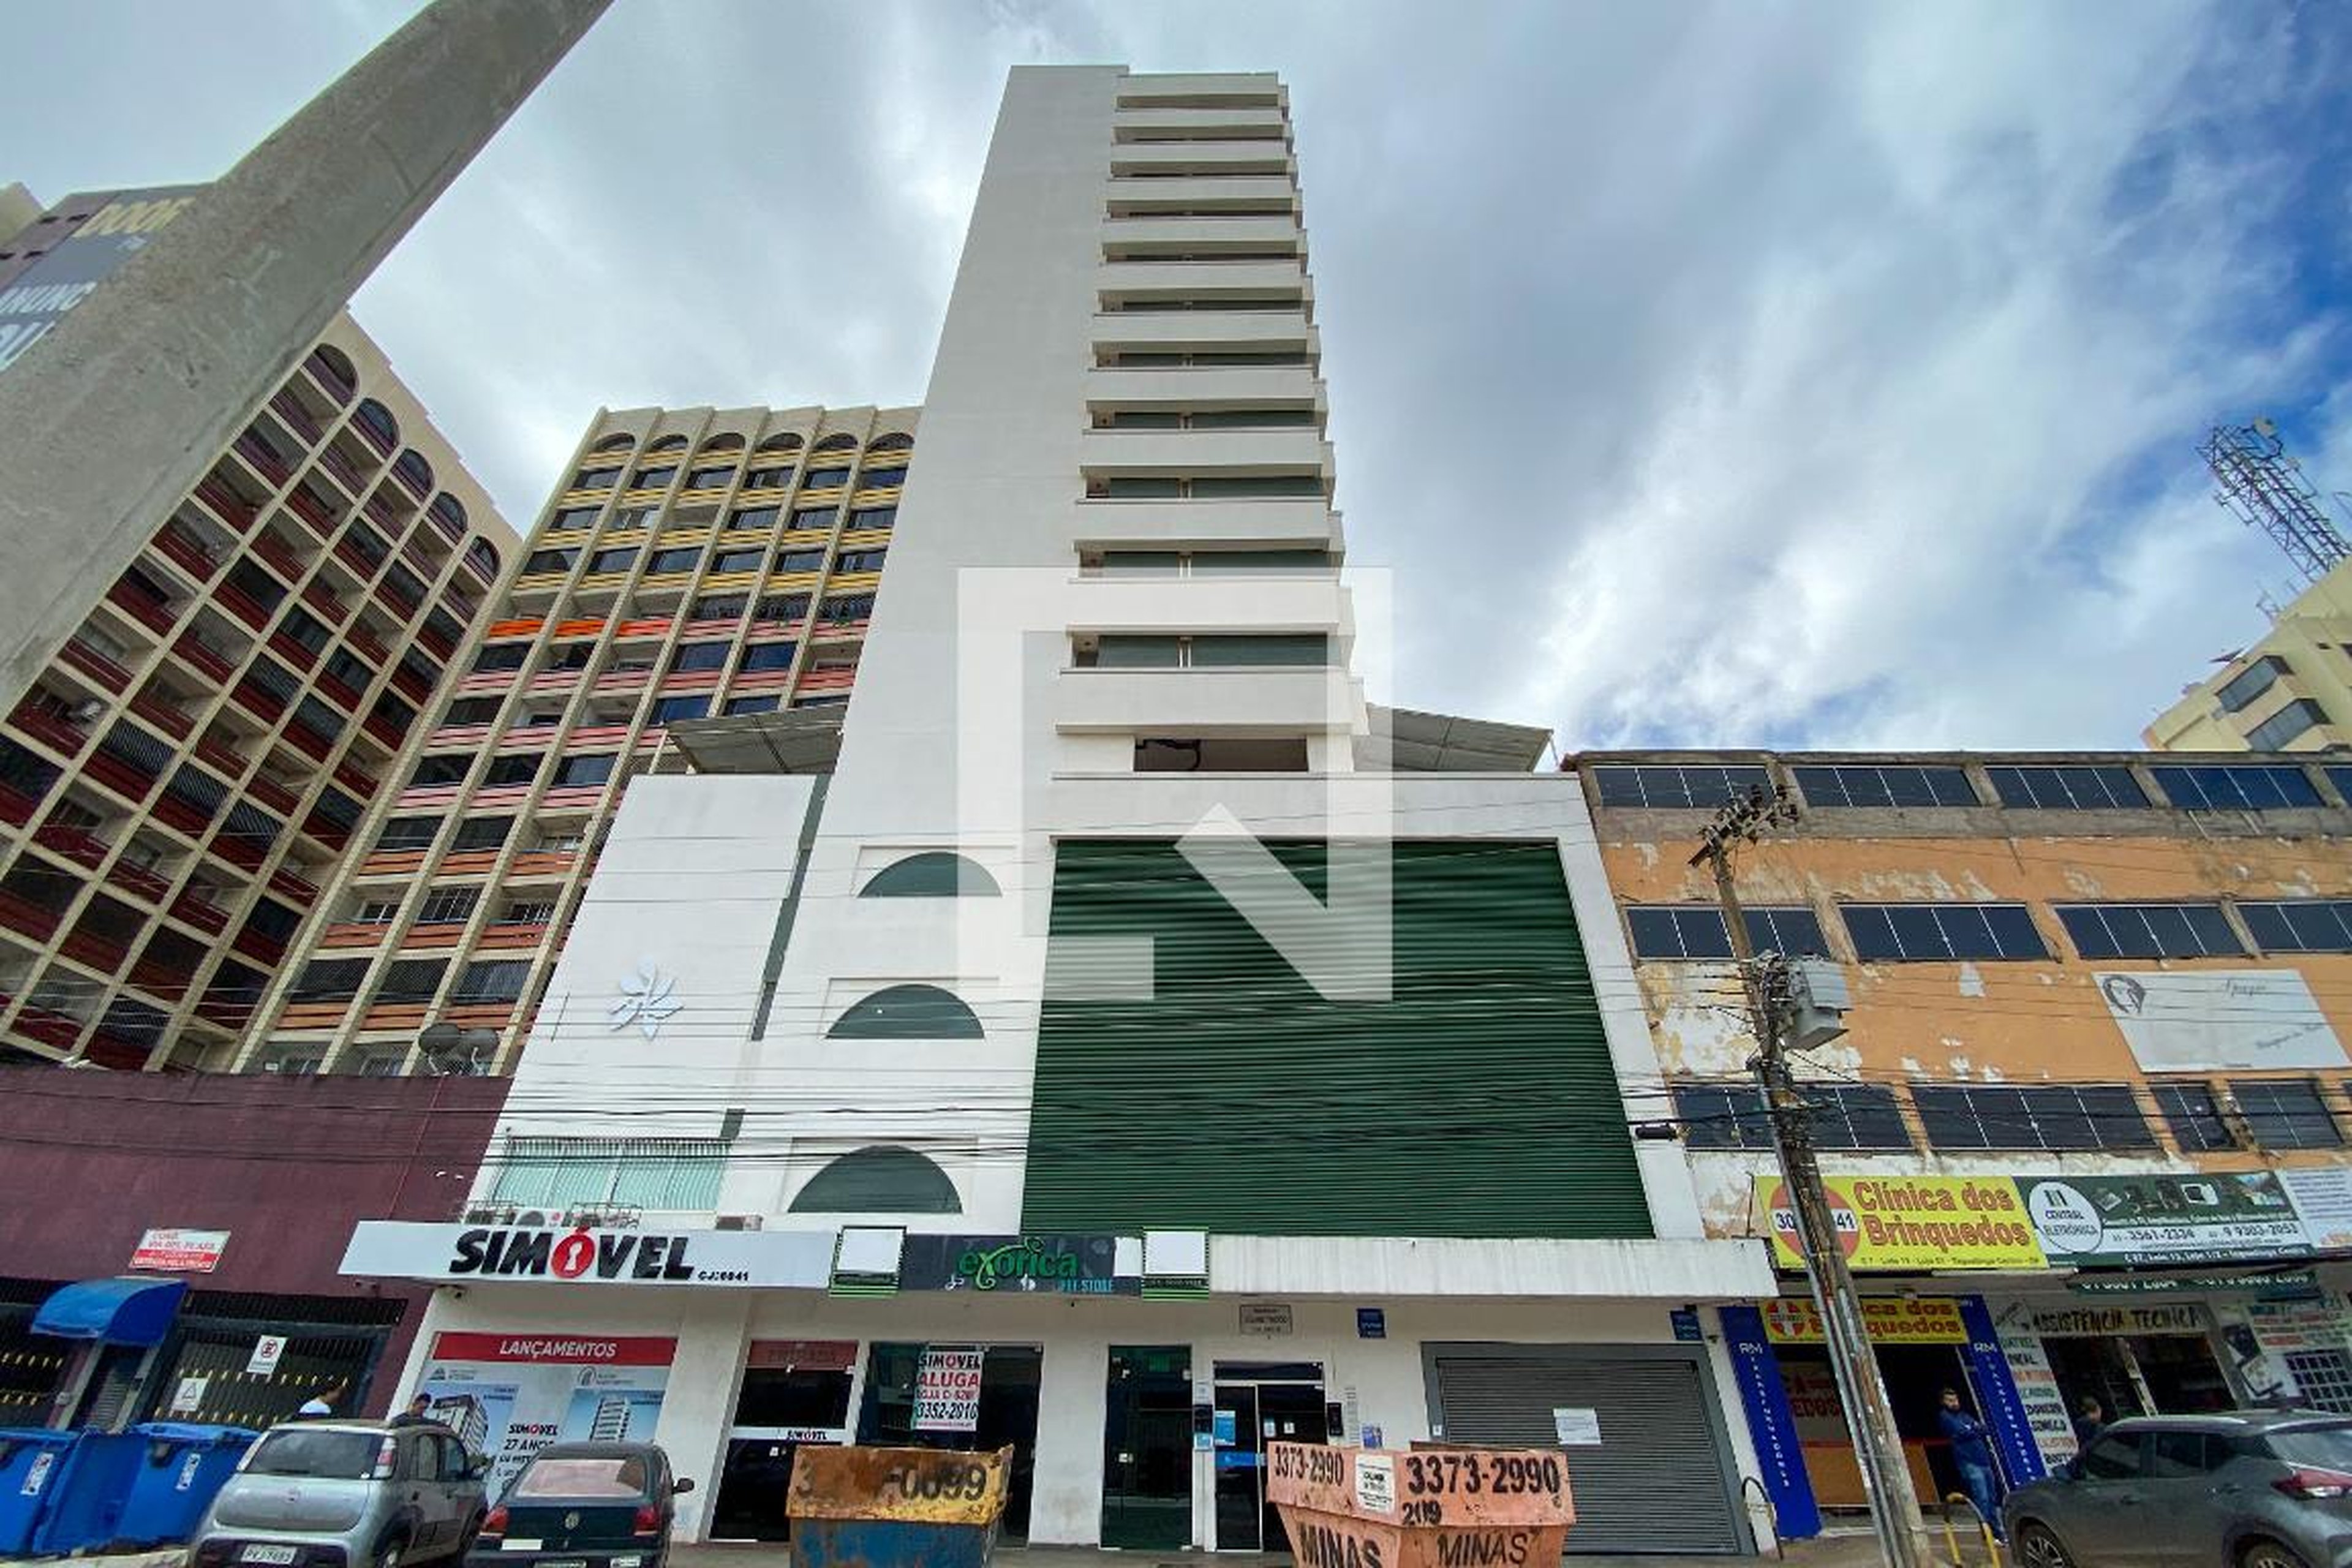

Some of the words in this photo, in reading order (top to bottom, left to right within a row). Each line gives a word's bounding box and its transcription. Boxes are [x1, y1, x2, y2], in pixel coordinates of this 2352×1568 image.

[1961, 1182, 2015, 1212] dos
[1861, 1215, 2030, 1251] Brinquedos
[499, 1340, 617, 1359] LANÇAMENTOS
[918, 1372, 980, 1387] ALUGA
[1275, 1446, 1344, 1487] 3373-2990
[1406, 1455, 1561, 1494] 3373-2990
[1296, 1522, 1384, 1568] MINAS
[1436, 1531, 1528, 1568] MINAS
